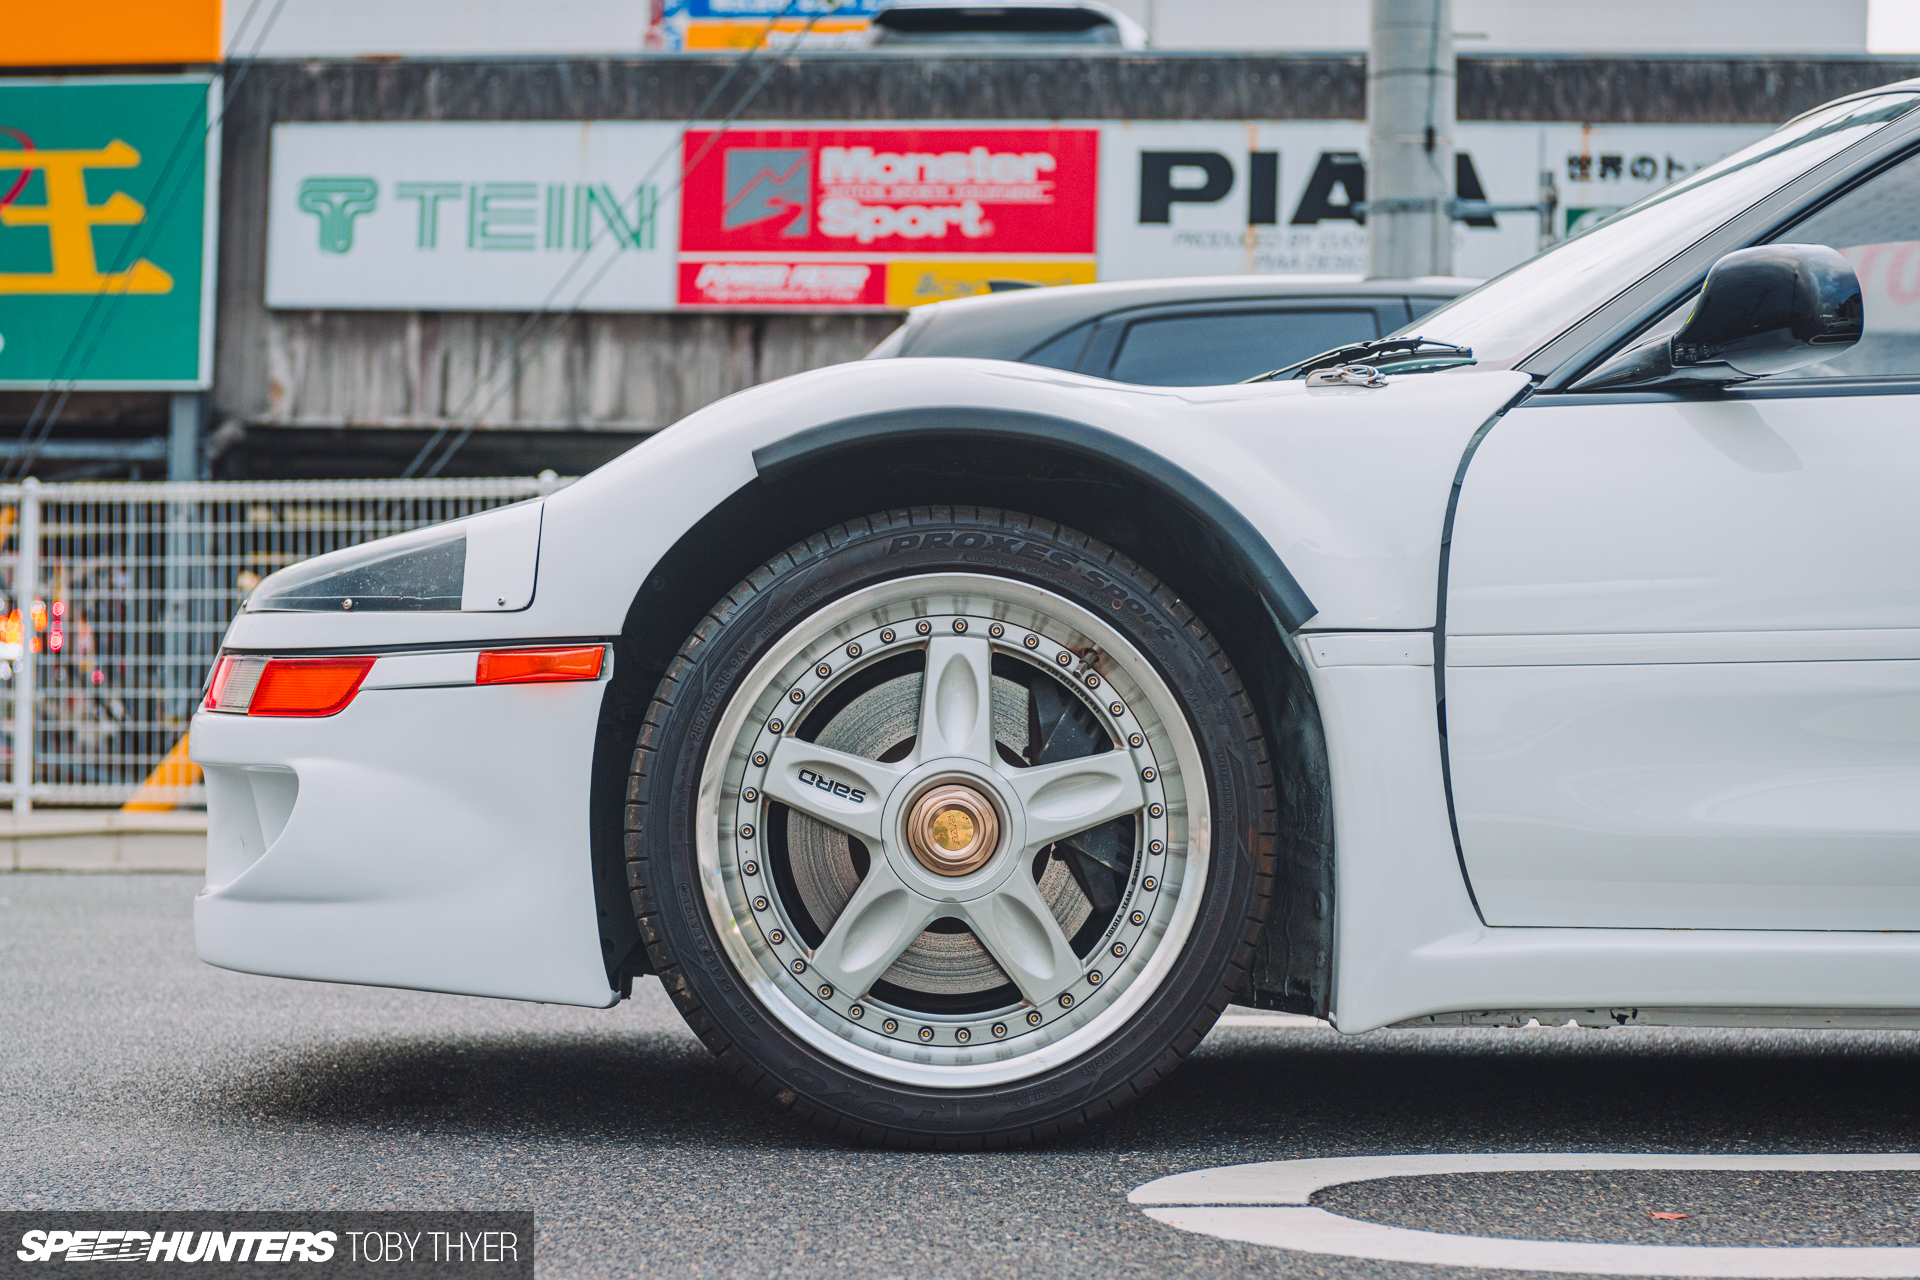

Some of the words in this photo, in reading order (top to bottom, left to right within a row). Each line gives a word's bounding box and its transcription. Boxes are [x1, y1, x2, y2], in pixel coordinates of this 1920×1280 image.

[820, 146, 1056, 184] Monster
[395, 182, 657, 250] TEIN
[887, 532, 1079, 572] PROXES
[729, 643, 752, 668] 94Y
[1105, 913, 1122, 938] TOYOTA
[1121, 890, 1132, 910] TEAM
[735, 999, 757, 1023] DOT
[1080, 1045, 1121, 1076] OUTSIDE
[785, 1066, 943, 1126] TOYO
